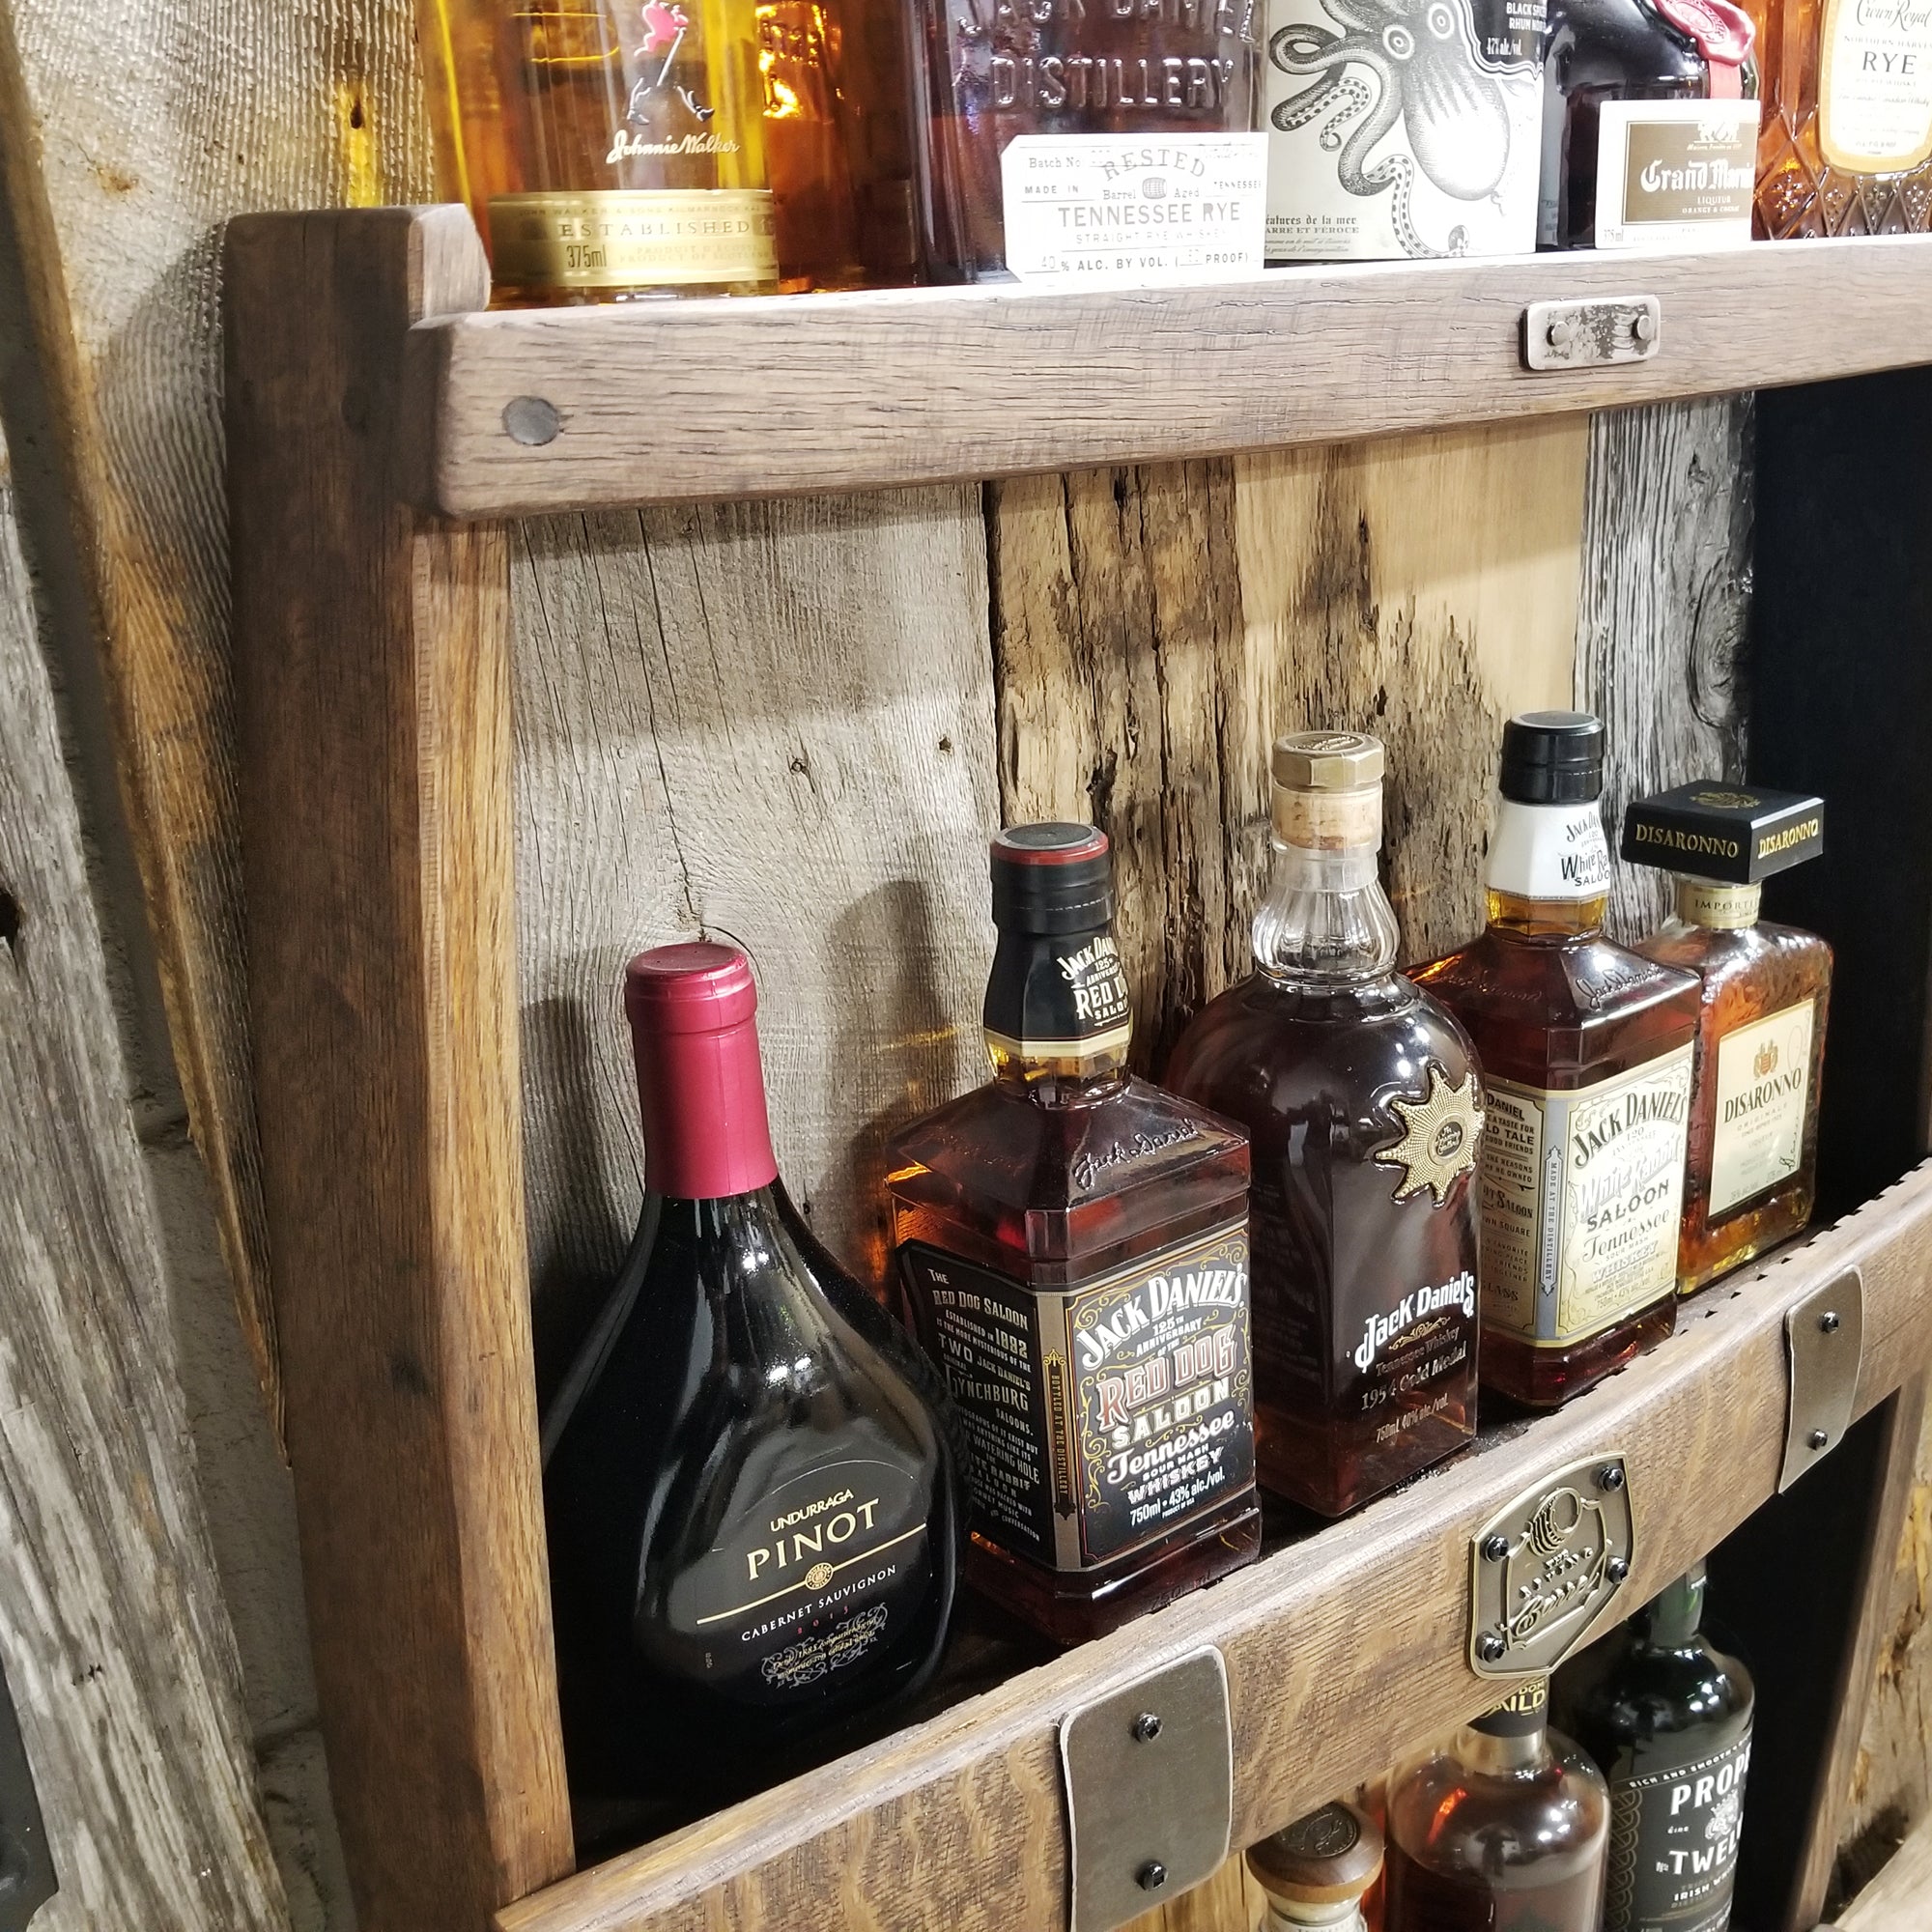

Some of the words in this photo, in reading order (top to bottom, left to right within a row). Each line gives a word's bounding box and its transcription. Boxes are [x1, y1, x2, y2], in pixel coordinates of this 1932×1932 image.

[1506, 1, 1532, 15] BLACK
[1862, 50, 1918, 75] RYE
[990, 56, 1236, 108] DISTILLERY
[606, 128, 678, 164] Johnnie
[675, 133, 741, 155] Walker
[1029, 157, 1062, 169] Batch
[1102, 148, 1207, 181] RESTED
[1640, 158, 1708, 192] Grand
[1024, 185, 1059, 194] MADE
[1066, 185, 1080, 193] IN
[1103, 188, 1137, 200] Barrel
[558, 219, 751, 237] ESTABLISHED
[1058, 203, 1193, 228] TENNESSEE
[1203, 201, 1240, 222] RYE
[566, 243, 608, 269] 375ml
[1077, 259, 1109, 271] ALC.
[1116, 257, 1133, 270] BY
[1140, 256, 1168, 269] VOL.
[1634, 823, 1739, 859] DISARONNO
[1757, 817, 1820, 860] DISARONNO
[1056, 945, 1095, 980] JACK
[1072, 981, 1114, 1020] RED
[1487, 1093, 1525, 1122] DANIEL
[1723, 1067, 1803, 1124] DISARONNO
[1504, 1128, 1535, 1146] TALE
[1572, 1107, 1623, 1170] JACK
[1625, 1087, 1689, 1131] DANIEL'S
[1504, 1139, 1534, 1155] FRIENDS
[1072, 1140, 1132, 1191] Jack
[1496, 1189, 1534, 1219] SALOON
[1548, 1191, 1556, 1202] AT
[1586, 1178, 1670, 1234] SALOON
[1499, 1220, 1531, 1237] SQUARE
[1582, 1208, 1670, 1263] Tennessee
[1545, 1227, 1554, 1281] DISTILLERY
[927, 1267, 950, 1285] THE
[1416, 1269, 1475, 1319] Daniel's
[932, 1290, 955, 1306] RED
[957, 1291, 980, 1310] DOG
[983, 1297, 1029, 1332] SALOON
[1075, 1294, 1151, 1372] JACK
[1148, 1262, 1248, 1322] DANIEL'S
[937, 1332, 974, 1364] TWO
[946, 1309, 986, 1337] ESTABLISHED
[994, 1327, 1028, 1360] 1892
[1136, 1317, 1203, 1358] ANNIVERSARY
[1095, 1356, 1171, 1433] RED
[1173, 1323, 1237, 1388] DOG
[1376, 1346, 1426, 1378] Tennessee
[1051, 1375, 1063, 1412] BOTTLED
[1054, 1414, 1064, 1426] AT
[1112, 1377, 1232, 1449] SALOON
[1055, 1429, 1065, 1445] THE
[1107, 1408, 1236, 1485] Tennessee
[1016, 1458, 1040, 1485] HOLE
[1056, 1448, 1068, 1494] DISTILLERY
[1126, 1445, 1225, 1505] WHISKEY
[1142, 1460, 1176, 1482] SOUR
[1178, 1442, 1209, 1465] MASH
[769, 1488, 855, 1532] UNDURRAGA
[1129, 1497, 1162, 1527] 750ml
[1168, 1483, 1190, 1506] 43%
[746, 1497, 879, 1581] PINOT
[741, 1604, 813, 1642] CABERNET
[818, 1564, 896, 1609] SAUVIGNON
[1629, 1776, 1659, 1788] RICH
[1662, 1769, 1687, 1780] AND
[1690, 1749, 1732, 1773] SMOOTH
[1673, 1883, 1711, 1902] IRISH
